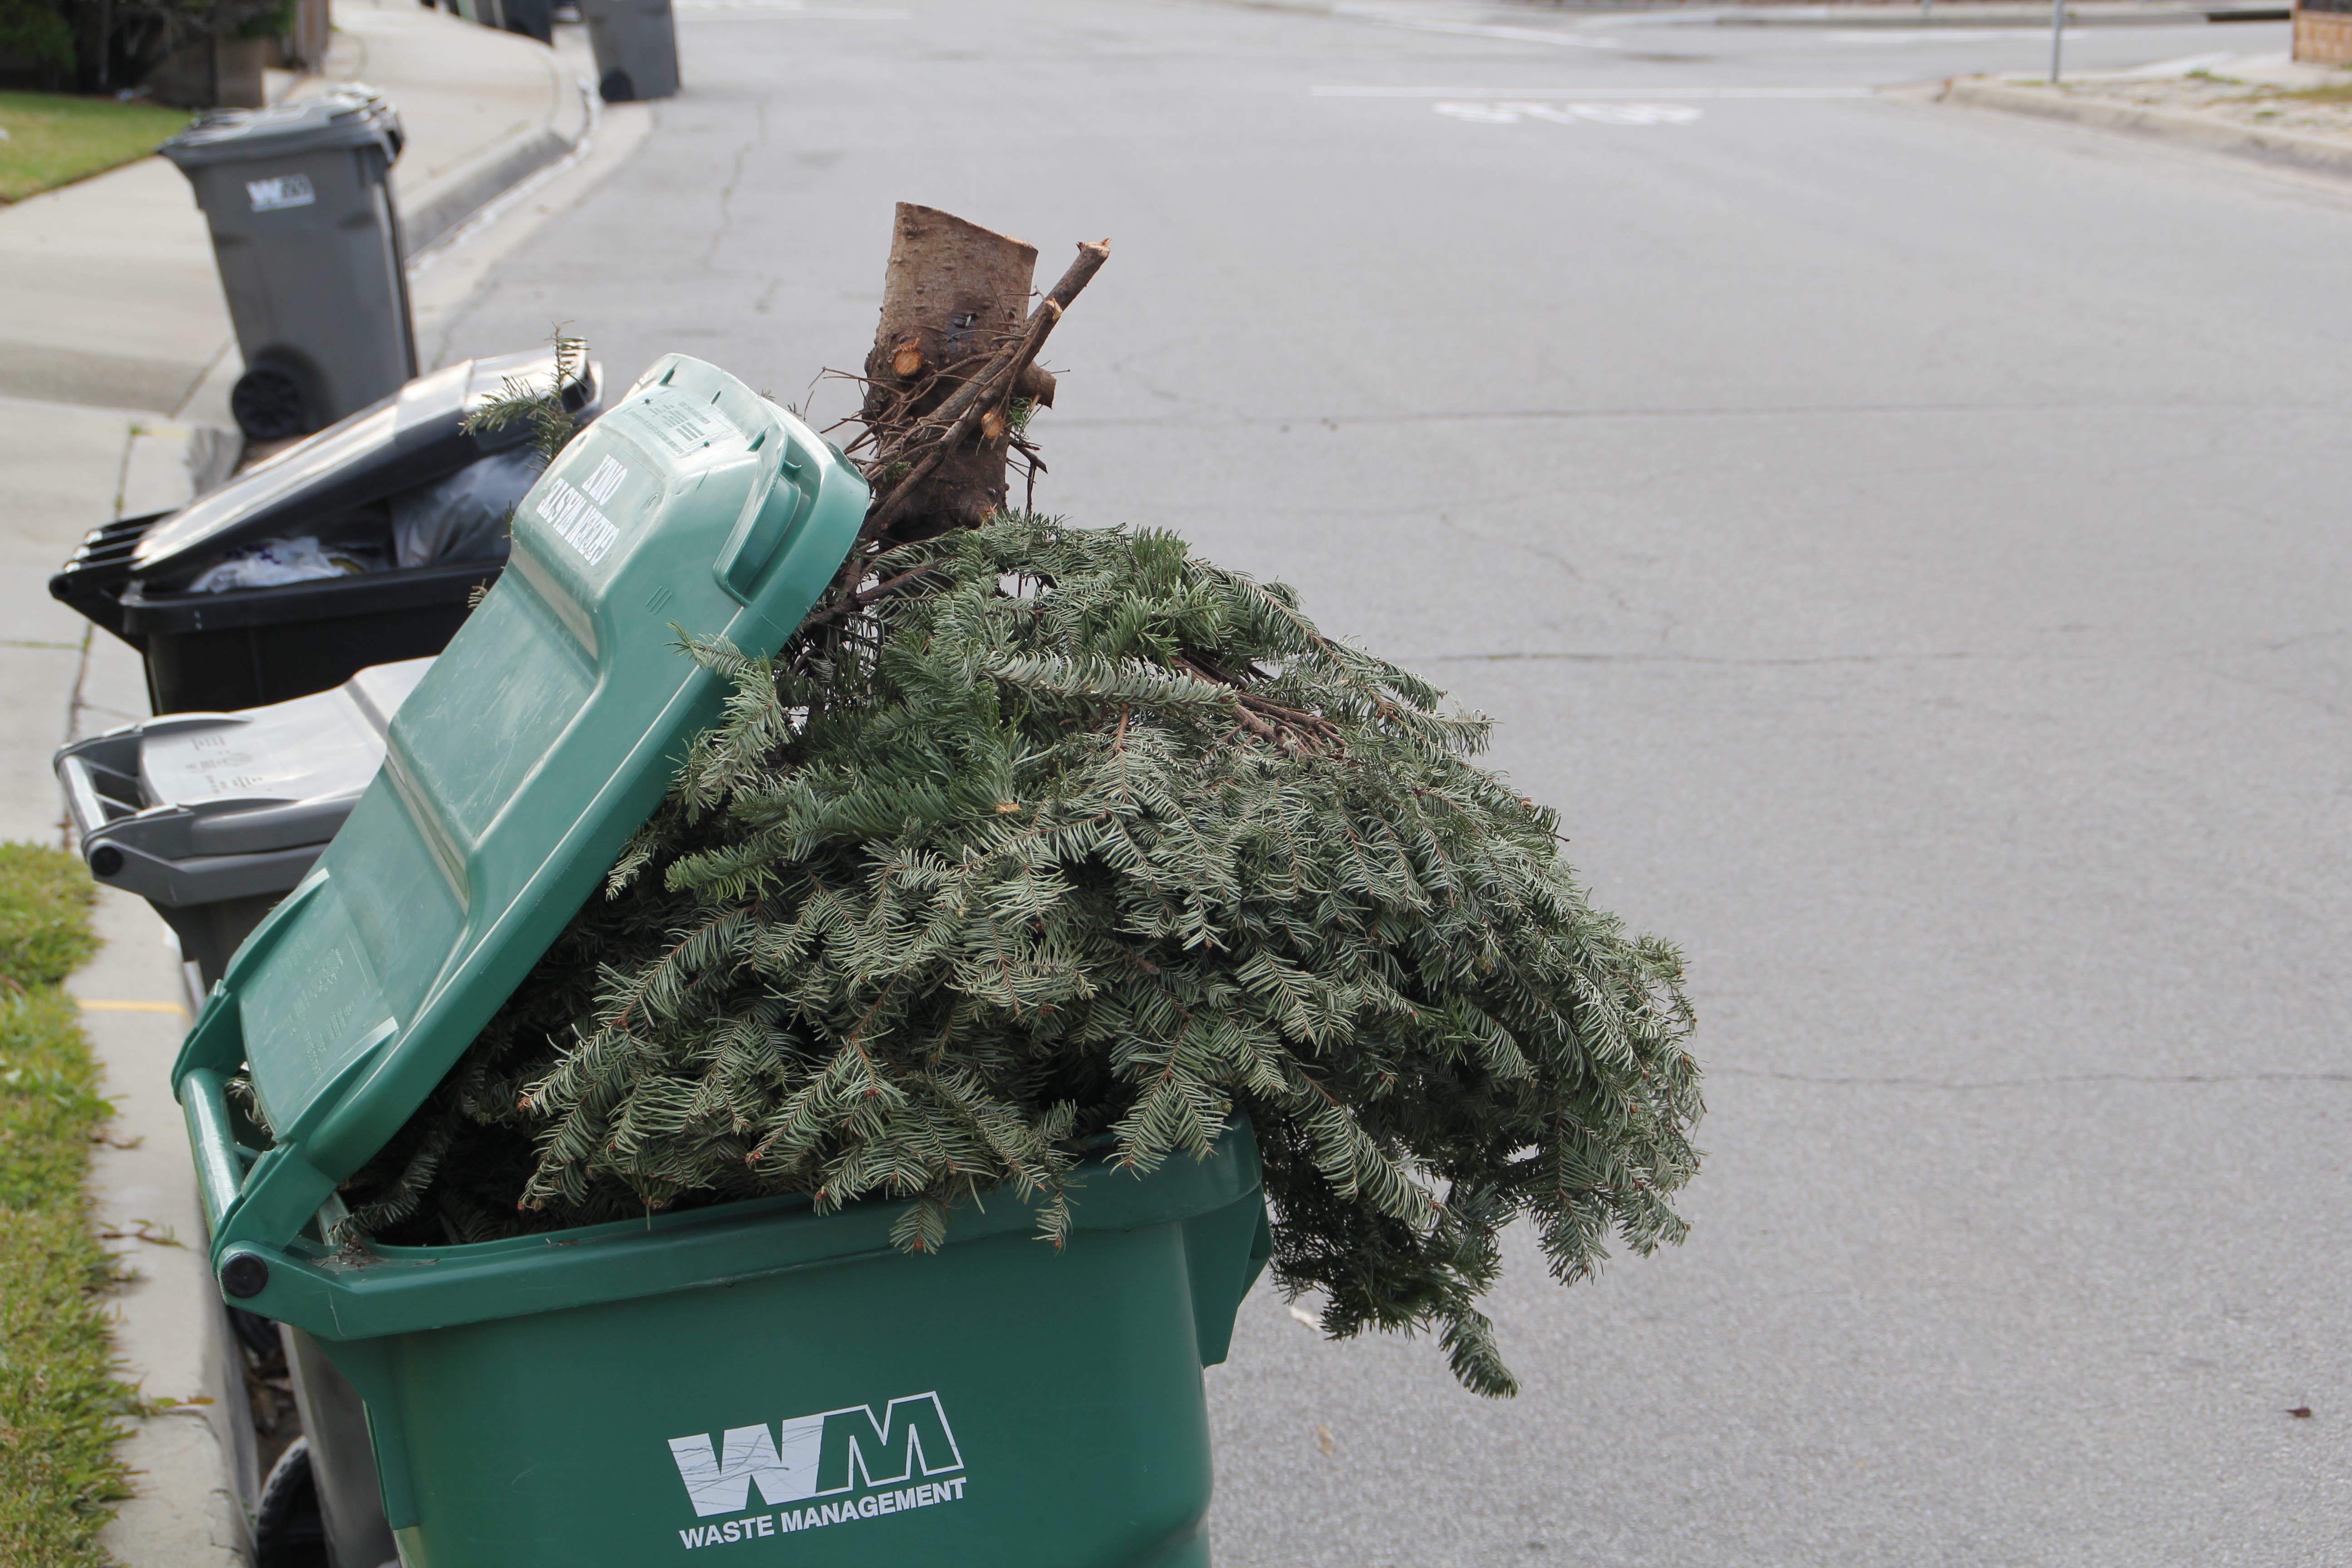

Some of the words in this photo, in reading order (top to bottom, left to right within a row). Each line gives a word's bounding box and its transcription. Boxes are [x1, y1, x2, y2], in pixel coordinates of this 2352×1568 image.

[536, 477, 587, 536] WASTE
[581, 454, 627, 505] ONLY
[564, 505, 620, 566] GREEN
[667, 1391, 964, 1517] WM
[679, 1515, 775, 1550] WASTE
[780, 1477, 967, 1533] MANAGEMENT
